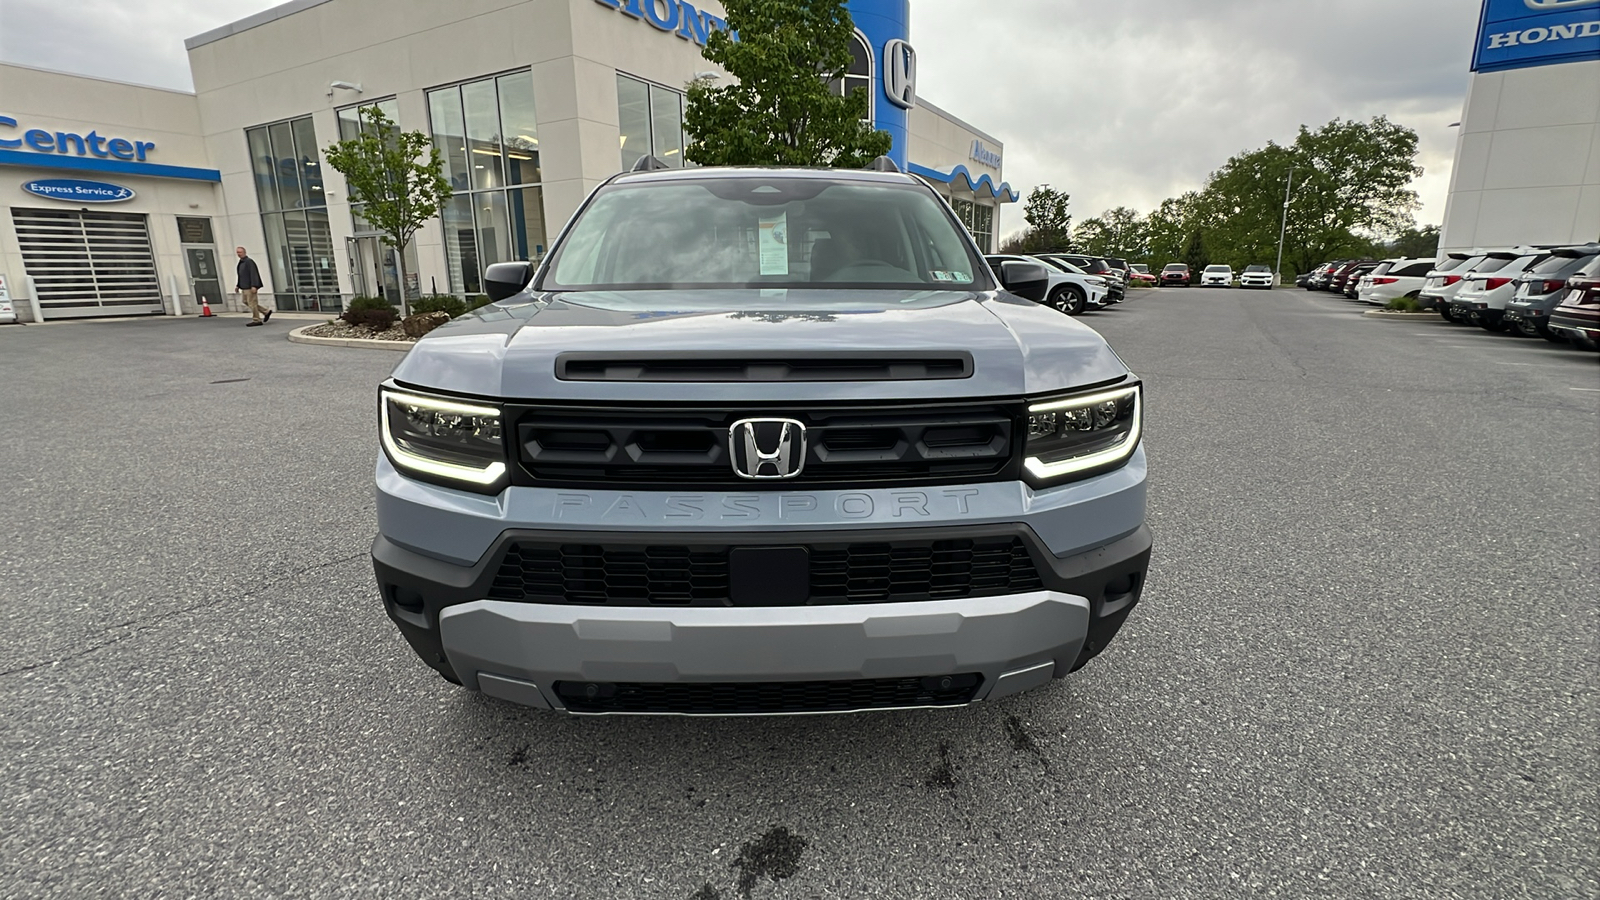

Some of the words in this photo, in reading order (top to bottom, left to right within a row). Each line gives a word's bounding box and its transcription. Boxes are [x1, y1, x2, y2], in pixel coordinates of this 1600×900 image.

[30, 183, 73, 194] Express
[75, 186, 114, 196] Service
[552, 488, 979, 521] PASSPORT
